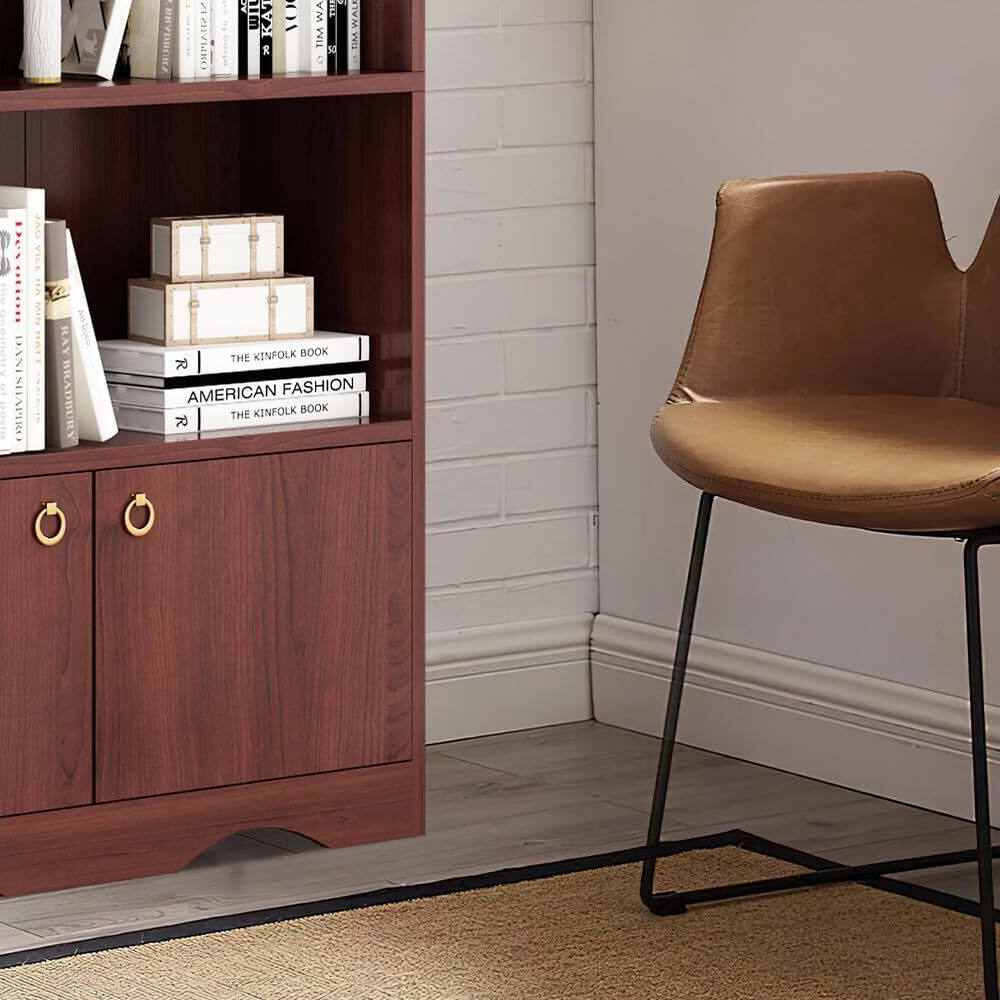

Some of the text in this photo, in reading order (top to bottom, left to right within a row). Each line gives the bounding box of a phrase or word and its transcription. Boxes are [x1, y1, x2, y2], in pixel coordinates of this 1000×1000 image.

[315, 27, 324, 49] TIM
[351, 30, 359, 50] TIM
[14, 221, 23, 324] Devotion
[230, 347, 329, 363] THE KINFOLK BOOK
[15, 335, 24, 442] DANI SHAPIRO
[61, 326, 76, 441] RAY BRADBURY
[187, 377, 355, 404] AMERICAN FASHION
[230, 403, 329, 420] THE KINFOLK BOOK
